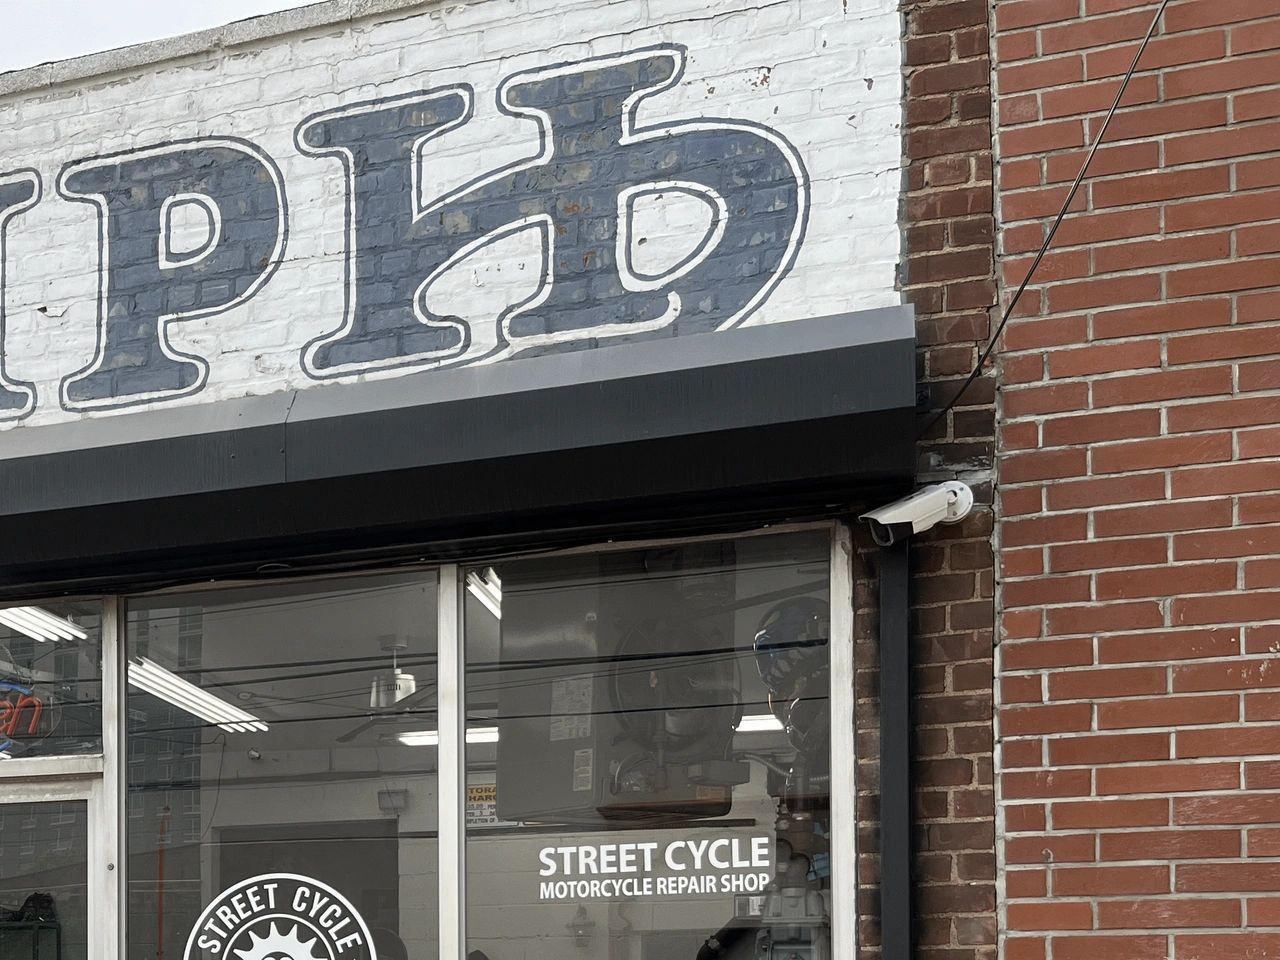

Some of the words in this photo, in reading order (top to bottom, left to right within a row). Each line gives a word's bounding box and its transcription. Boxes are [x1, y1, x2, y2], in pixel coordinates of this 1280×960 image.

[539, 842, 658, 877] STREET
[665, 837, 770, 871] CYCLE
[539, 879, 652, 899] MOTORCYCLE
[657, 875, 717, 895] REPAIR
[720, 873, 770, 893] SHOP
[197, 883, 278, 954] STREET
[292, 886, 363, 954] CYCLE
